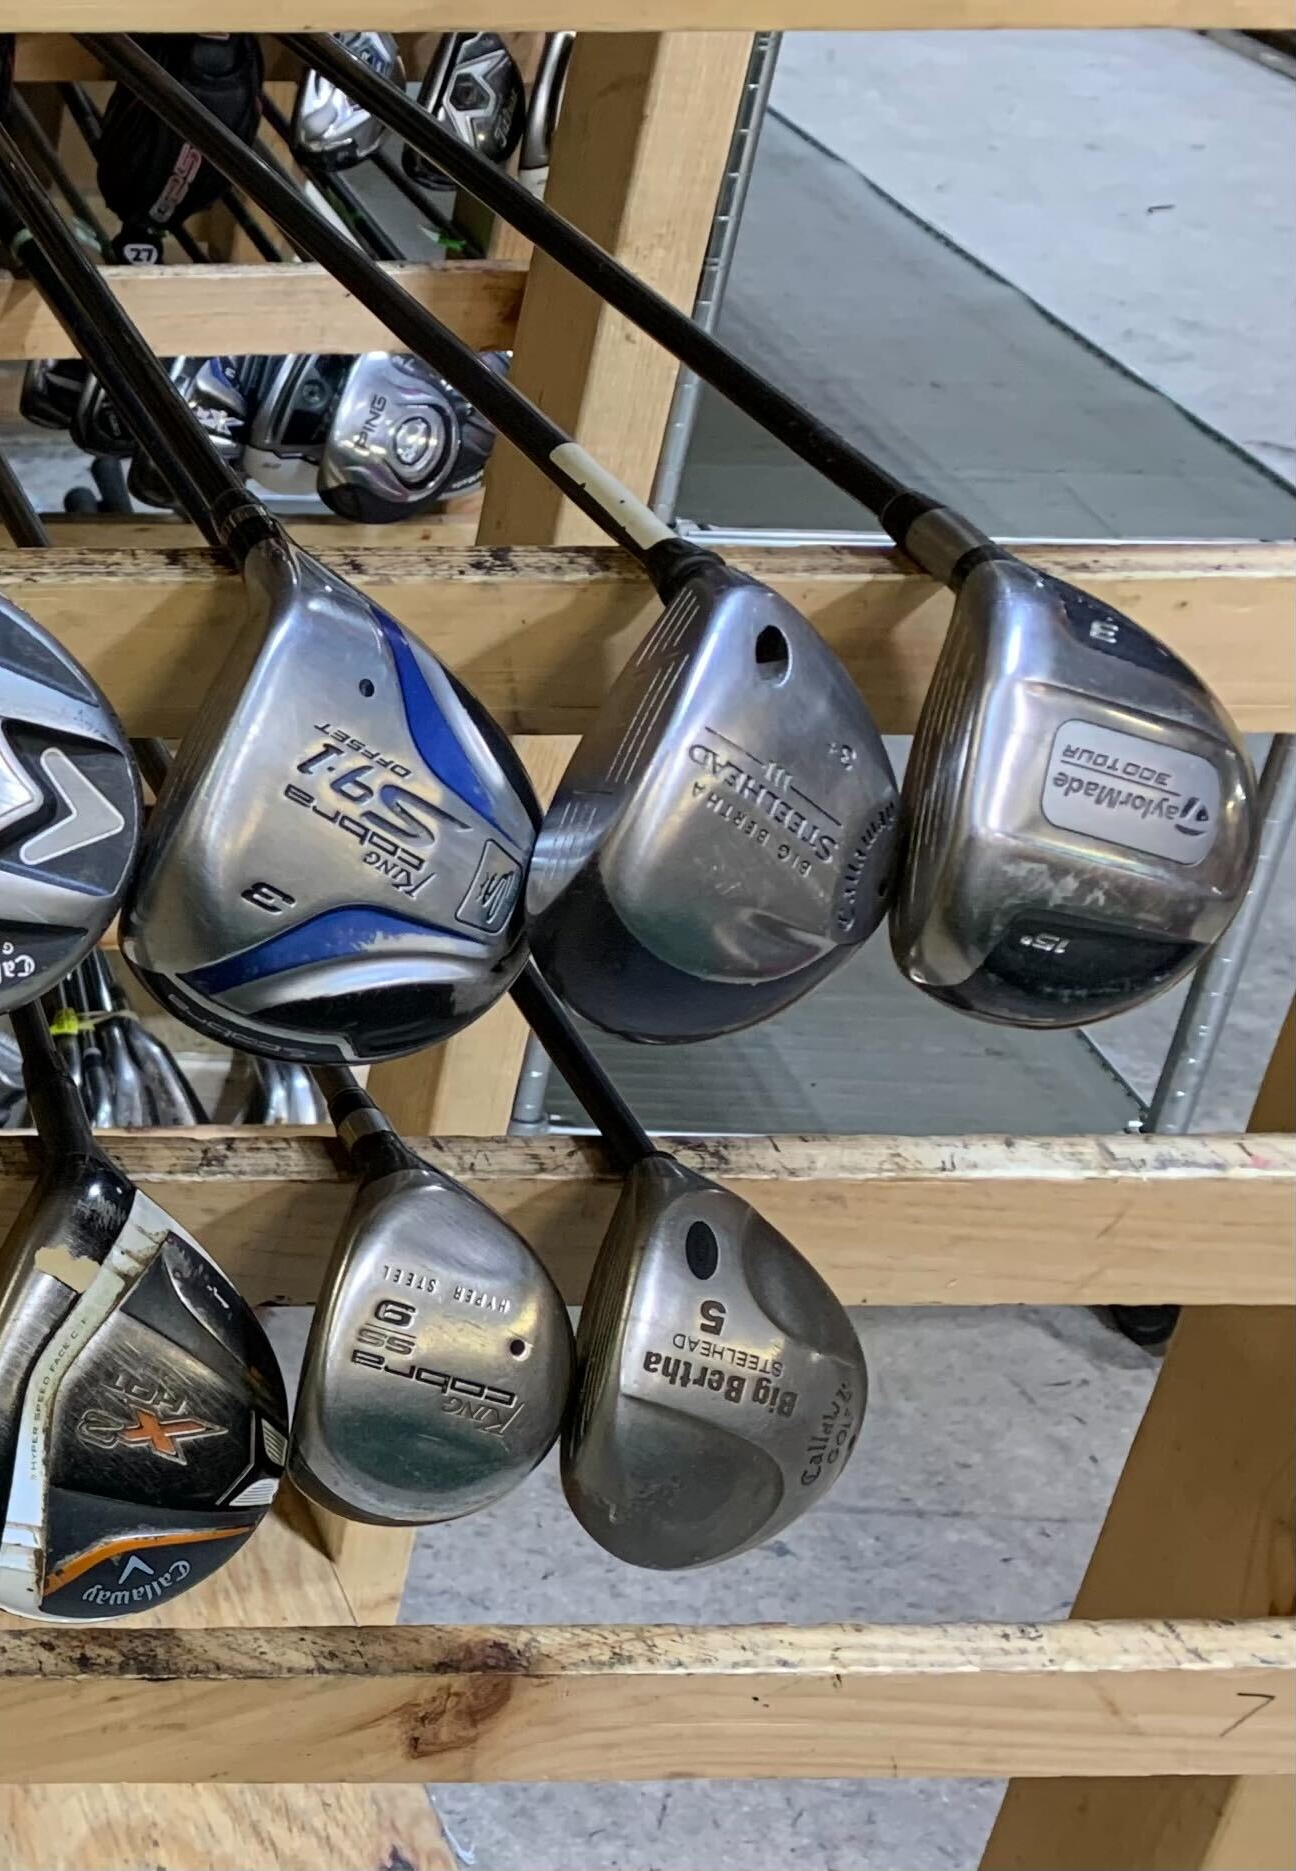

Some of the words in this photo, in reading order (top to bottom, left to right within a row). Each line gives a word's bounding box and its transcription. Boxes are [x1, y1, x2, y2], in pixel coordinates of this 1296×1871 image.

[129, 247, 154, 262] 27
[356, 393, 388, 450] PING
[1089, 618, 1120, 644] 3
[313, 721, 414, 781] OFFSET
[1061, 743, 1121, 773] TOUR
[1124, 765, 1173, 788] 300
[687, 742, 837, 865] STEELHEAD
[692, 781, 768, 848] BERTHA
[1052, 770, 1210, 836] TaylorMade
[777, 843, 812, 879] BIG
[240, 881, 296, 916] 3
[383, 1264, 437, 1294] STEEL
[452, 1285, 511, 1314] HYPER
[699, 1299, 728, 1337] 5
[355, 1327, 417, 1357] SS
[672, 1332, 785, 1378] STEELHEAD
[350, 1349, 518, 1408] cobra
[642, 1349, 747, 1406] Bertha
[34, 1376, 52, 1423] SPEED
[440, 1396, 525, 1437] KING
[751, 1379, 799, 1419] Big
[82, 1558, 193, 1606] Callaway
[1219, 1690, 1276, 1738] 7
